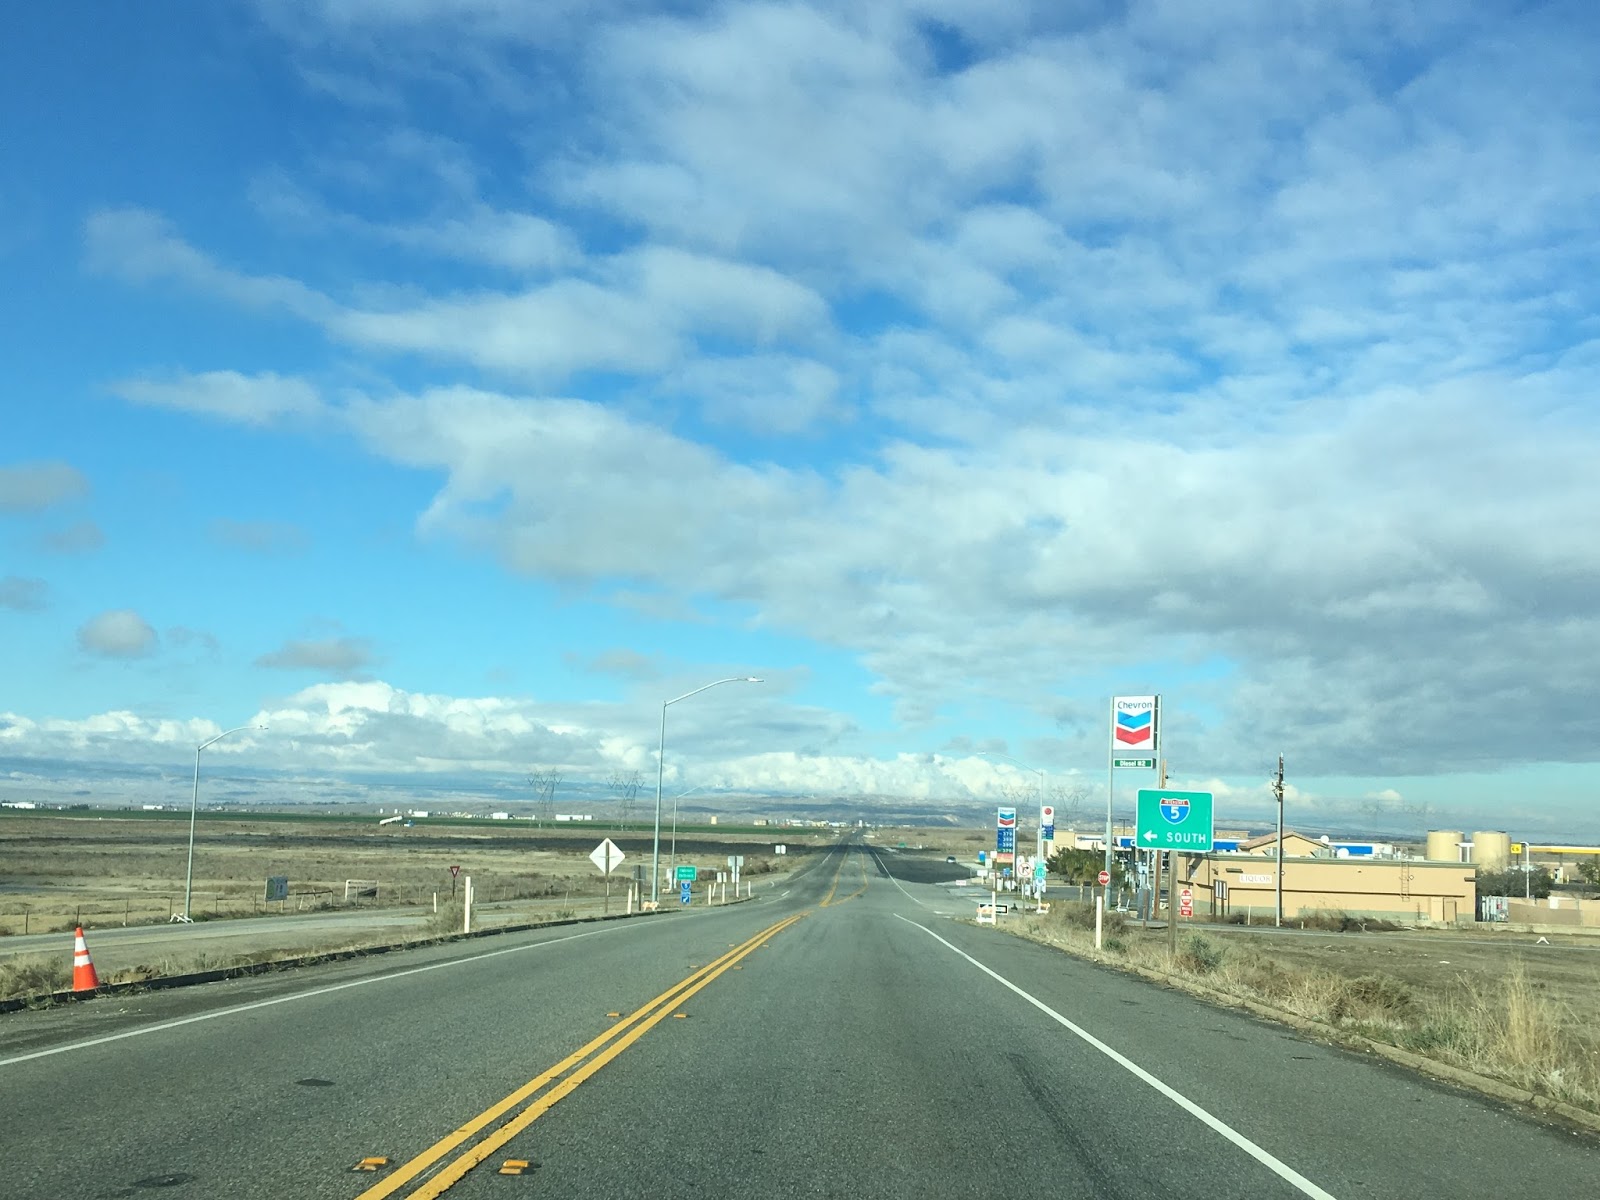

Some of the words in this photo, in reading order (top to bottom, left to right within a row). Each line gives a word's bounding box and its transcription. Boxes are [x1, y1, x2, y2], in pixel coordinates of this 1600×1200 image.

[1117, 701, 1152, 709] Chevron
[1170, 806, 1180, 819] 5
[1166, 832, 1206, 844] SOUTH
